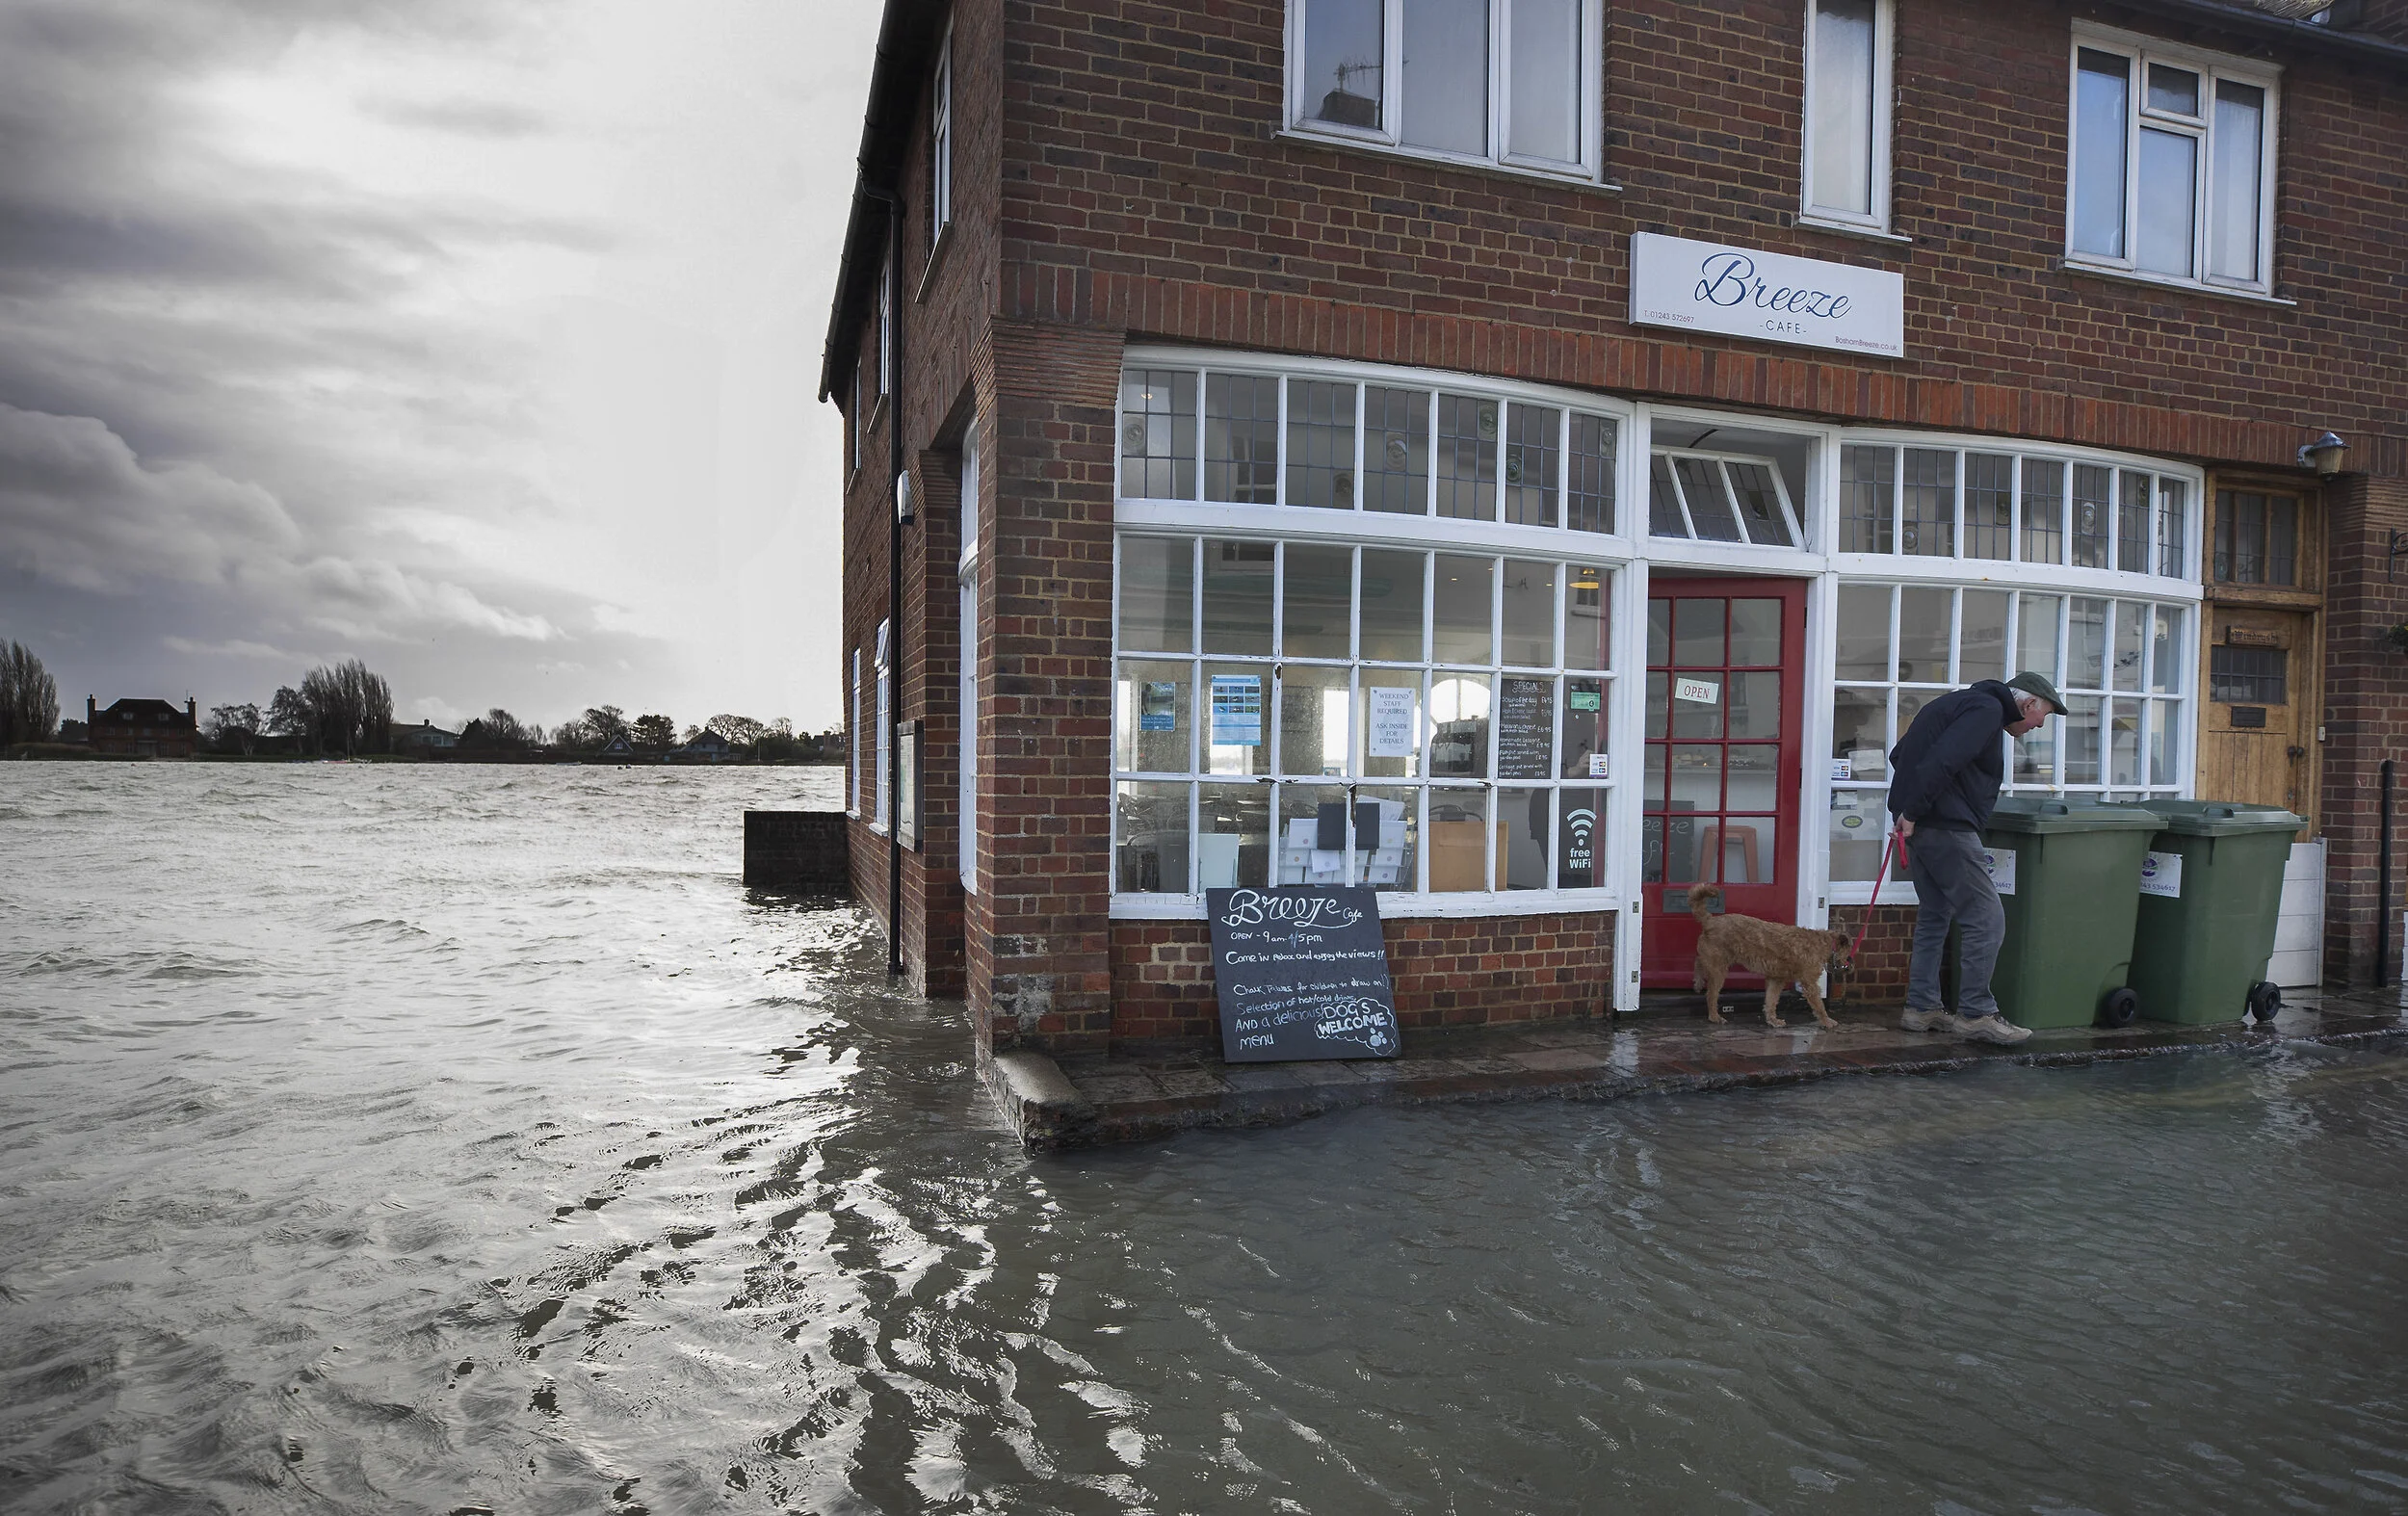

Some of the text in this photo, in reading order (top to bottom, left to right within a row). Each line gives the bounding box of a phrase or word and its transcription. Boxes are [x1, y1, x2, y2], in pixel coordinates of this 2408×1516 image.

[1694, 252, 1852, 319] Breeze
[1650, 311, 1670, 321] 01243
[1835, 336, 1898, 352] BoshamBreeze.co.uk
[1513, 680, 1544, 691] SPECIALS
[1684, 685, 1710, 699] OPEN
[1643, 819, 1689, 834] eeze
[1570, 848, 1590, 857] free
[1569, 858, 1591, 869] WiFi
[1221, 889, 1363, 928] Breeze Cafe
[1230, 931, 1253, 940] OPEN
[1225, 951, 1257, 965] Come
[1335, 951, 1348, 960] the
[1296, 981, 1307, 992] for
[1350, 977, 1371, 988] draw
[1236, 1001, 1285, 1016] Selection
[1286, 997, 1296, 1006] of
[1322, 1002, 1371, 1020] DOGS
[1235, 1018, 1258, 1032] AND
[1272, 1006, 1322, 1026] delicious
[1318, 1012, 1388, 1035] WELCOME
